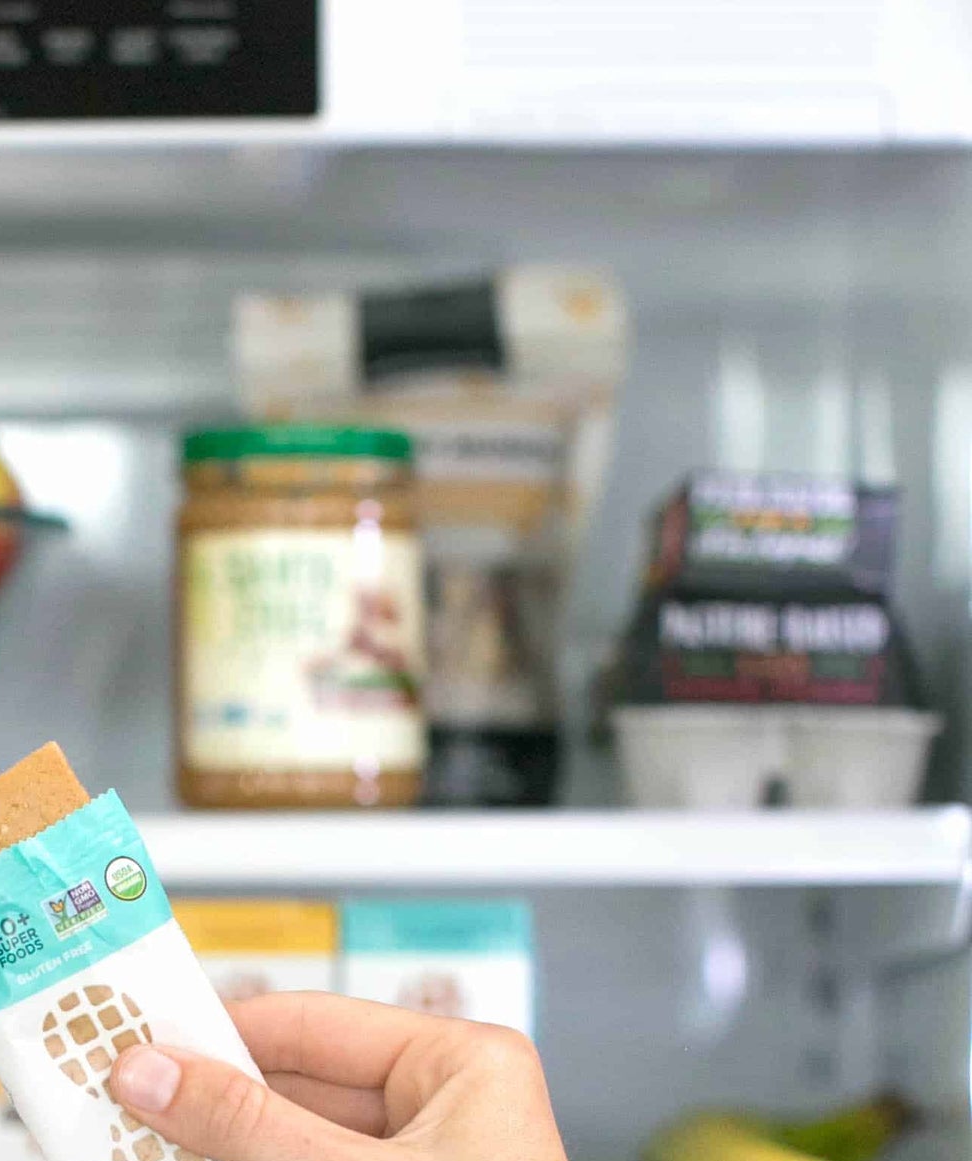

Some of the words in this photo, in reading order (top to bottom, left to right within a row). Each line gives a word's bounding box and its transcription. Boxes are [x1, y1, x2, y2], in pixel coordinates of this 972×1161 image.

[69, 882, 91, 898] NON
[74, 889, 95, 905] GMO
[0, 939, 44, 968] FOODS
[16, 958, 62, 985] GLUTEN
[63, 941, 93, 961] FREE
